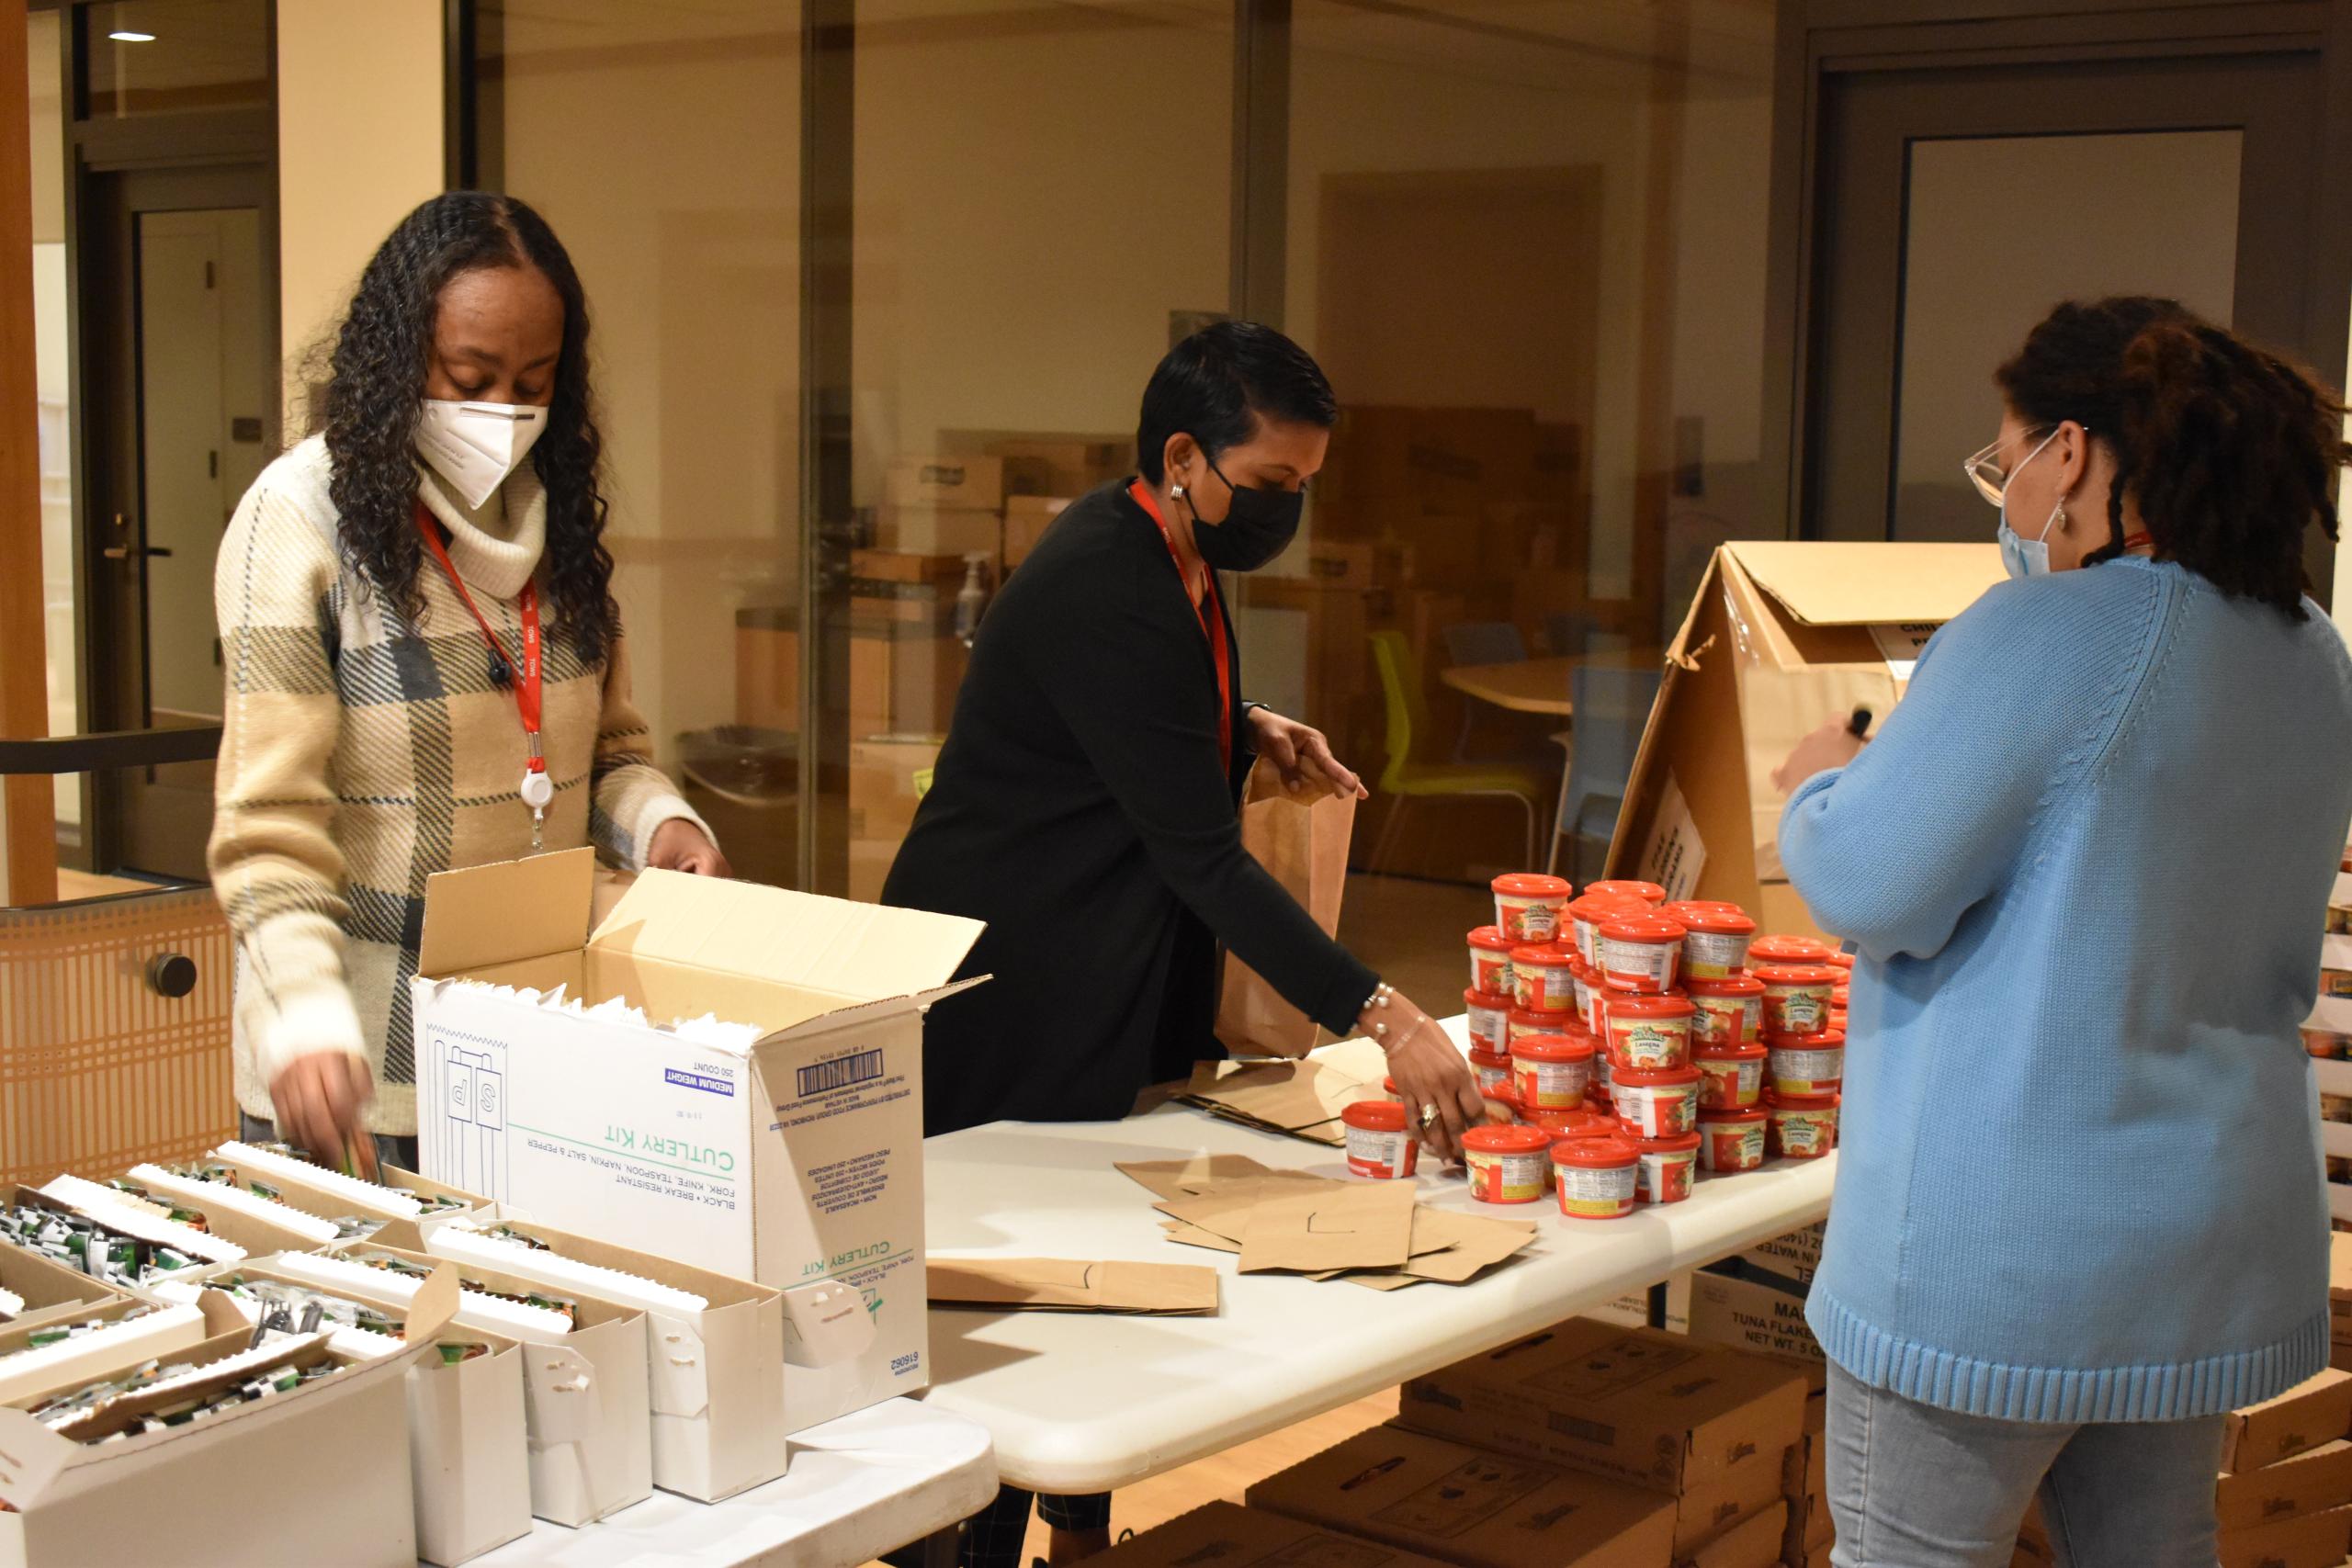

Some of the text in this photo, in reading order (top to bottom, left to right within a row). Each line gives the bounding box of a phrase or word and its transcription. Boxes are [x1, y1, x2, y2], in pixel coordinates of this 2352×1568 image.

[694, 1062, 734, 1077] 250 COUNT
[666, 1070, 733, 1094] MEDIUM WEIGHT
[480, 1083, 496, 1112] S
[527, 1138, 558, 1153] PEPPER
[567, 1149, 587, 1161] SALT
[605, 1125, 734, 1171] CUTLERY KIT
[616, 1174, 735, 1210] BLACK BREAK RESISTANT
[802, 1241, 890, 1276] CUTLERY KIT
[1802, 1251, 1815, 1264] IN
[867, 1272, 887, 1283] BLACK
[1774, 1301, 1805, 1322] MA
[1732, 1312, 1815, 1340] TUNA FLAKE
[1745, 1330, 1770, 1345] NET
[1800, 1342, 1807, 1354] 5
[890, 1351, 919, 1370] 616062
